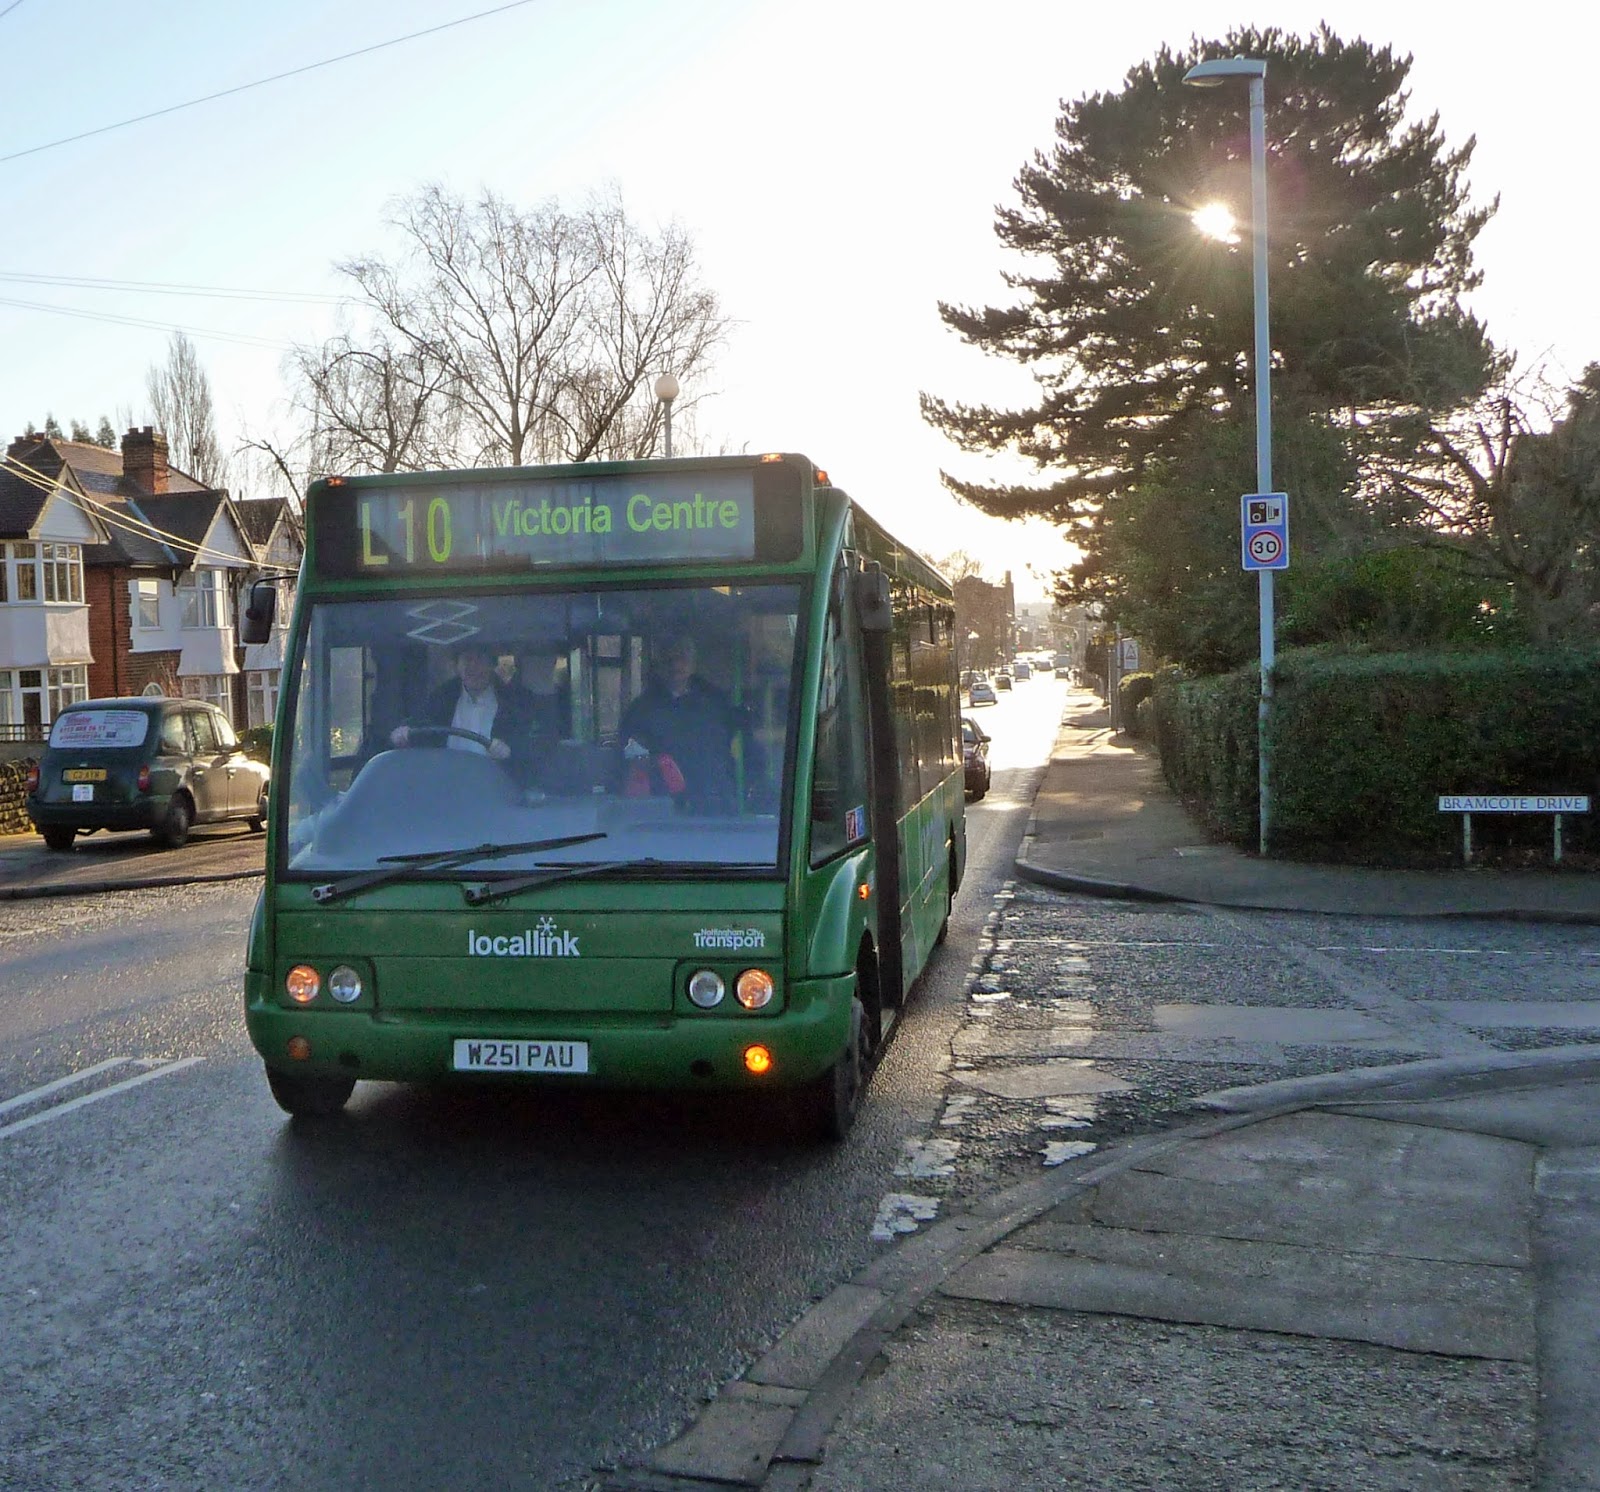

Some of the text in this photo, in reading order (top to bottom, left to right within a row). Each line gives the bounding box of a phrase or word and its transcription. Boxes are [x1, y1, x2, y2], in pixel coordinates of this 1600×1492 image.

[362, 493, 740, 566] L10 Victoria Centre
[1254, 541, 1277, 554] 30
[1443, 797, 1582, 809] BRAMCOTE DRIVE
[468, 923, 581, 957] locallink
[693, 932, 766, 951] Transport
[467, 1043, 574, 1068] W251 PAU
